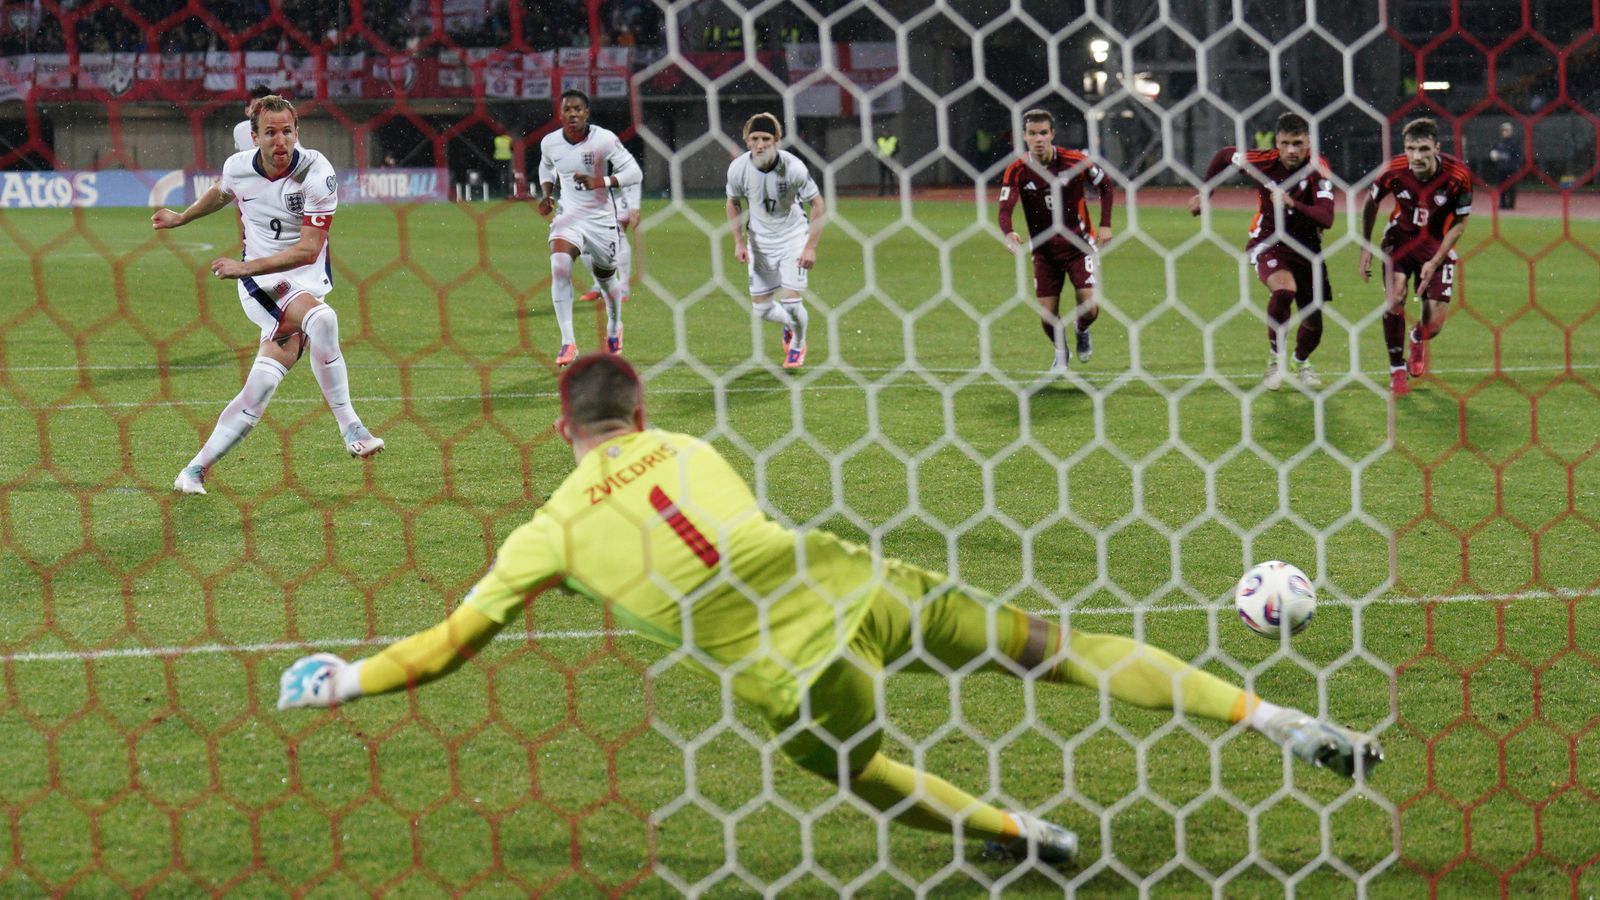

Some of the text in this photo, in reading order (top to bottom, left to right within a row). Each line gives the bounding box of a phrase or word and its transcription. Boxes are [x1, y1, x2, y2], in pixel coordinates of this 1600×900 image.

[763, 199, 777, 213] 17
[311, 215, 326, 227] C
[1413, 208, 1429, 226] 13
[270, 218, 282, 240] 9
[609, 241, 616, 258] 3
[1442, 264, 1455, 284] 13
[583, 443, 678, 506] ZVIEDRIS
[648, 484, 721, 569] 1
